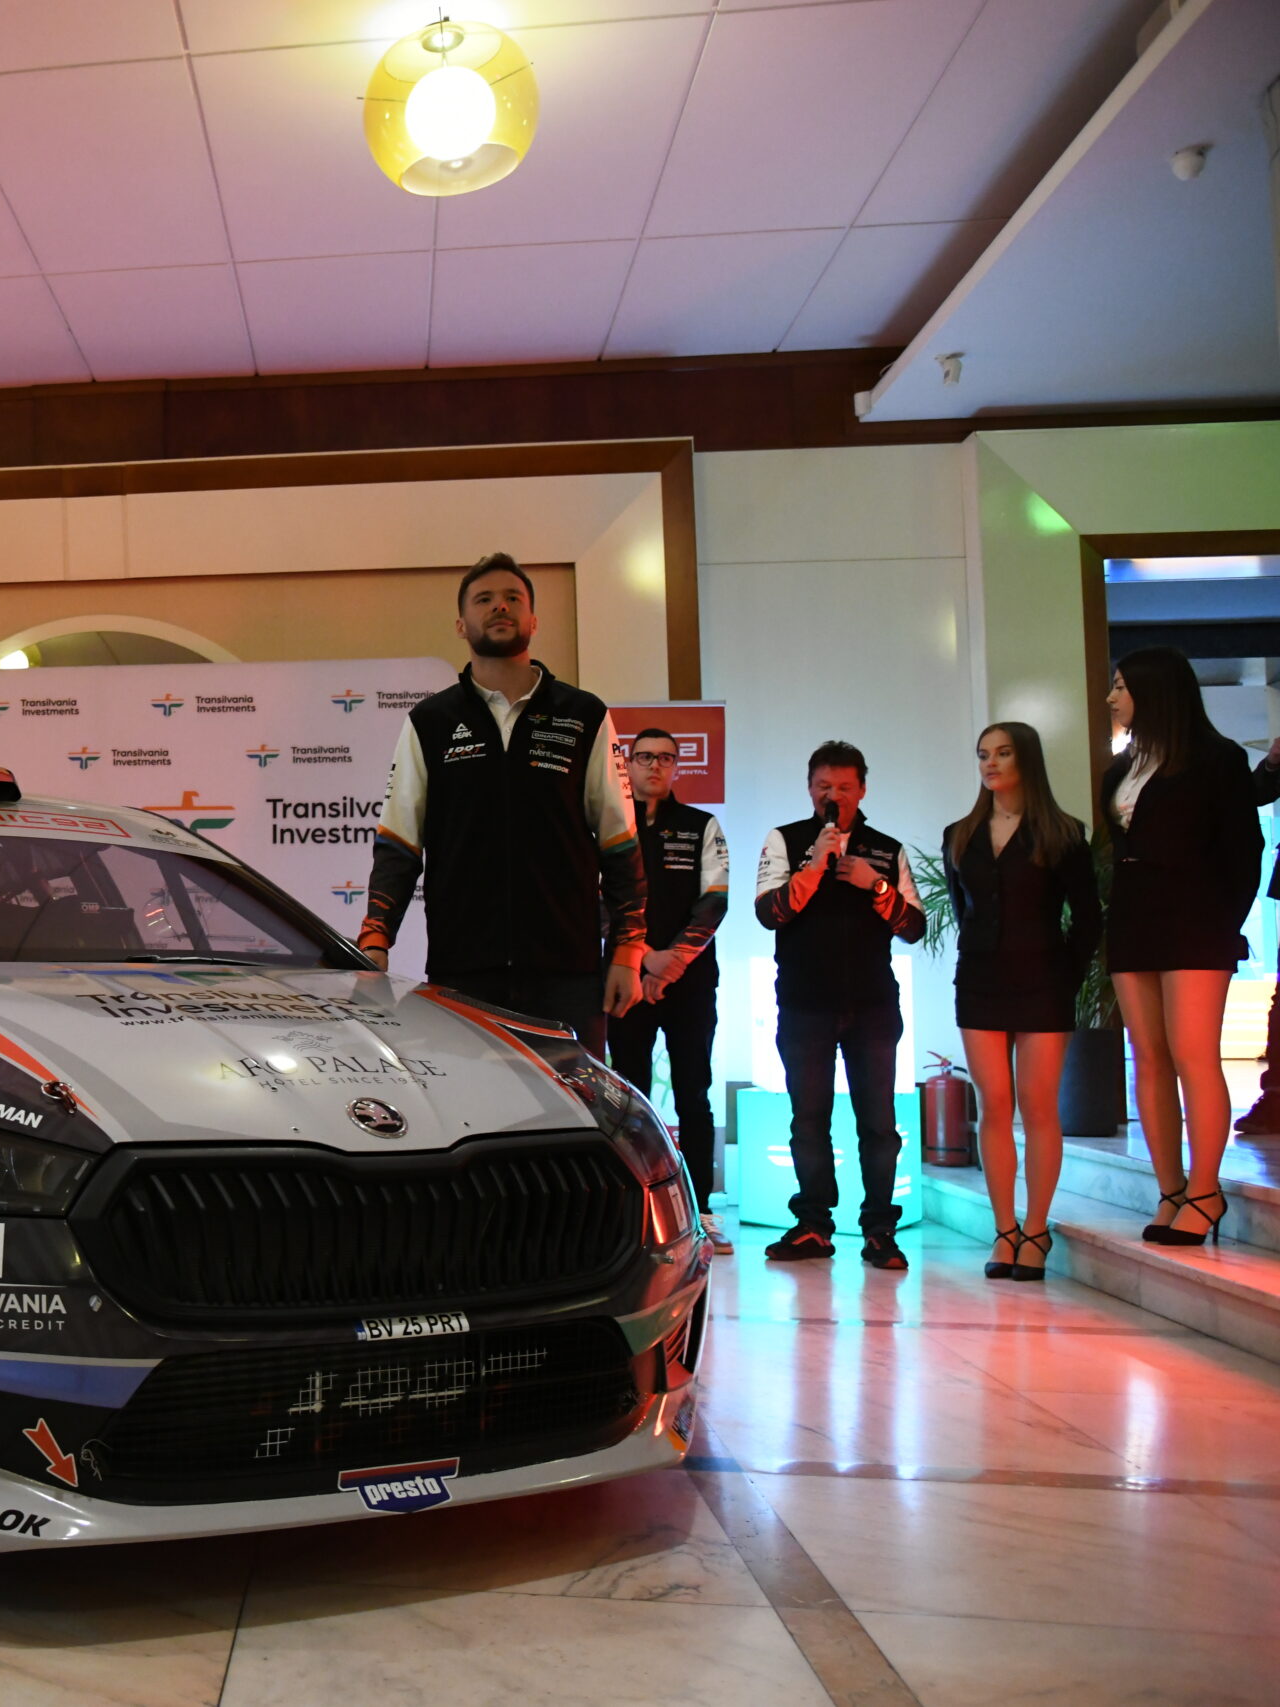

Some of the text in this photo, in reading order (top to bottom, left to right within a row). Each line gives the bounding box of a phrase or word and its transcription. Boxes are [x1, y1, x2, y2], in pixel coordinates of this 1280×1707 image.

[20, 698, 78, 707] Transilvania
[195, 695, 254, 704] Transilvania
[196, 704, 256, 713] Investments
[378, 701, 417, 709] Investm
[22, 707, 80, 716] Investments
[452, 730, 473, 740] PEAK
[111, 749, 169, 758] Transilvania
[291, 745, 350, 755] Transilvania
[112, 758, 171, 767] Investments
[292, 754, 352, 764] Investments
[272, 824, 377, 844] Investm
[75, 990, 358, 1006] Transilvana
[306, 1056, 447, 1076] PALACE
[329, 1076, 383, 1085] SINCE
[366, 1312, 462, 1339] BV 25 PRT
[364, 1476, 442, 1505] presto
